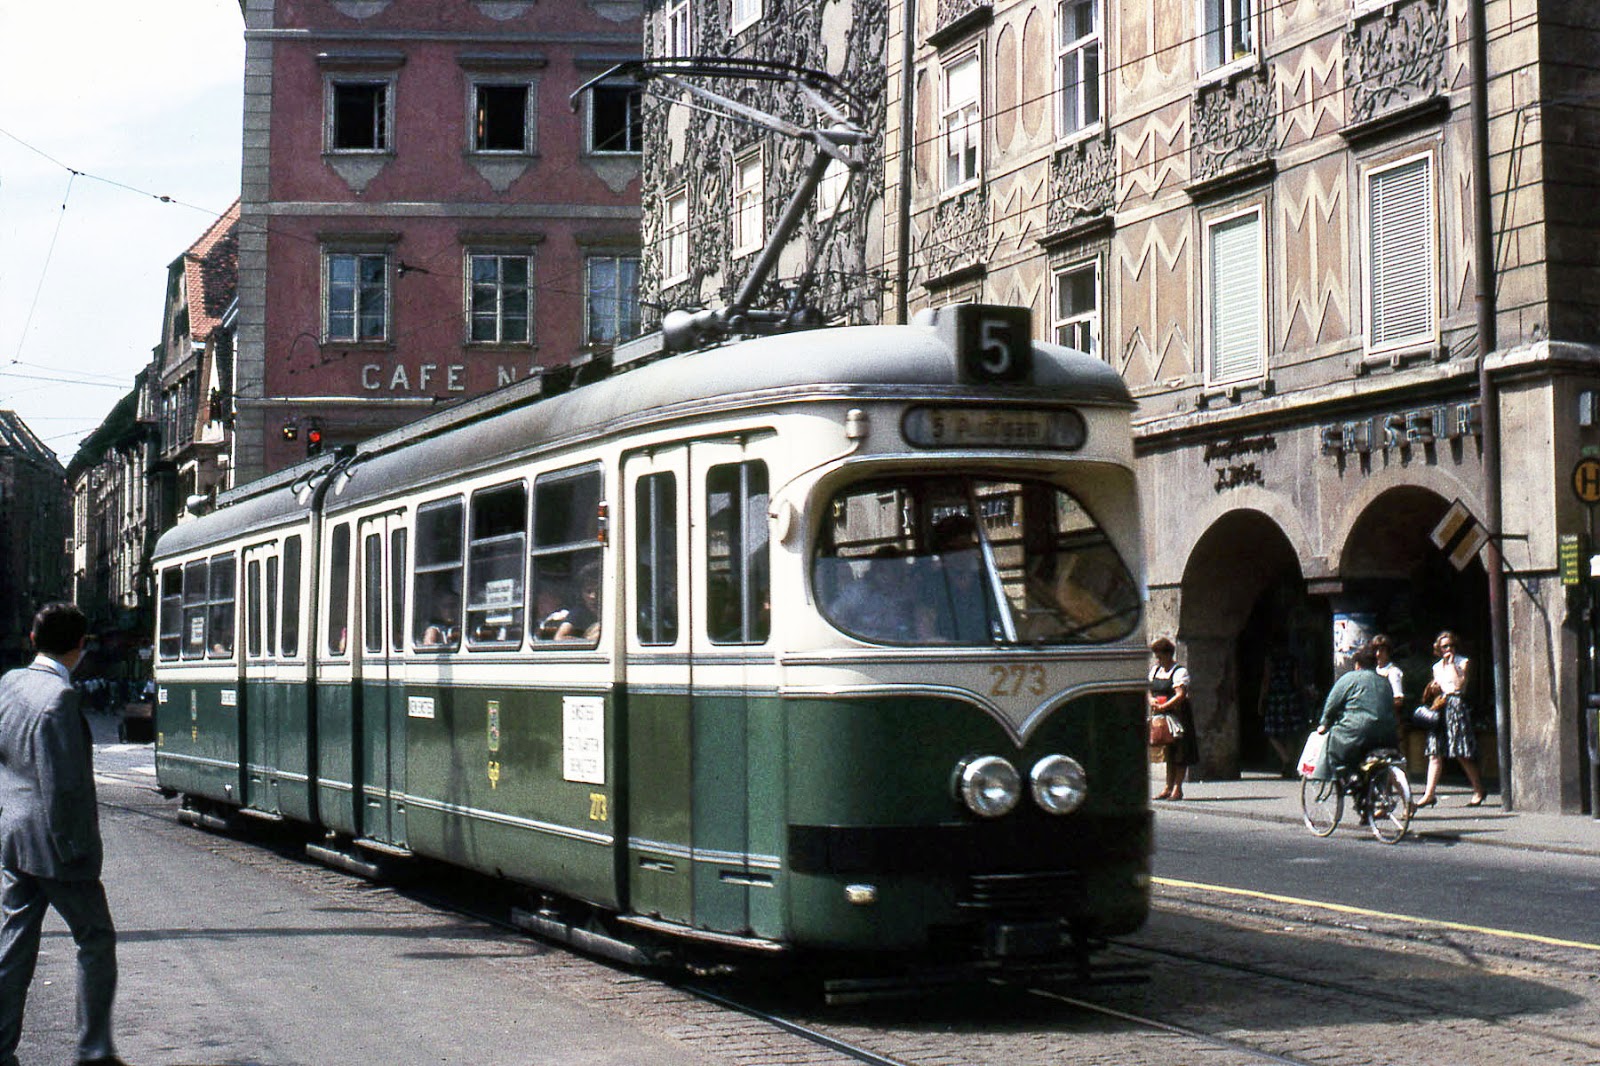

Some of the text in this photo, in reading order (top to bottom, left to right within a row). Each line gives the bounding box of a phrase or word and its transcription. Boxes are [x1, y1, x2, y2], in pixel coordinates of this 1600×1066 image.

[981, 320, 1011, 374] 5
[361, 364, 465, 391] CAFE
[1581, 467, 1600, 497] H
[991, 665, 1048, 696] 273
